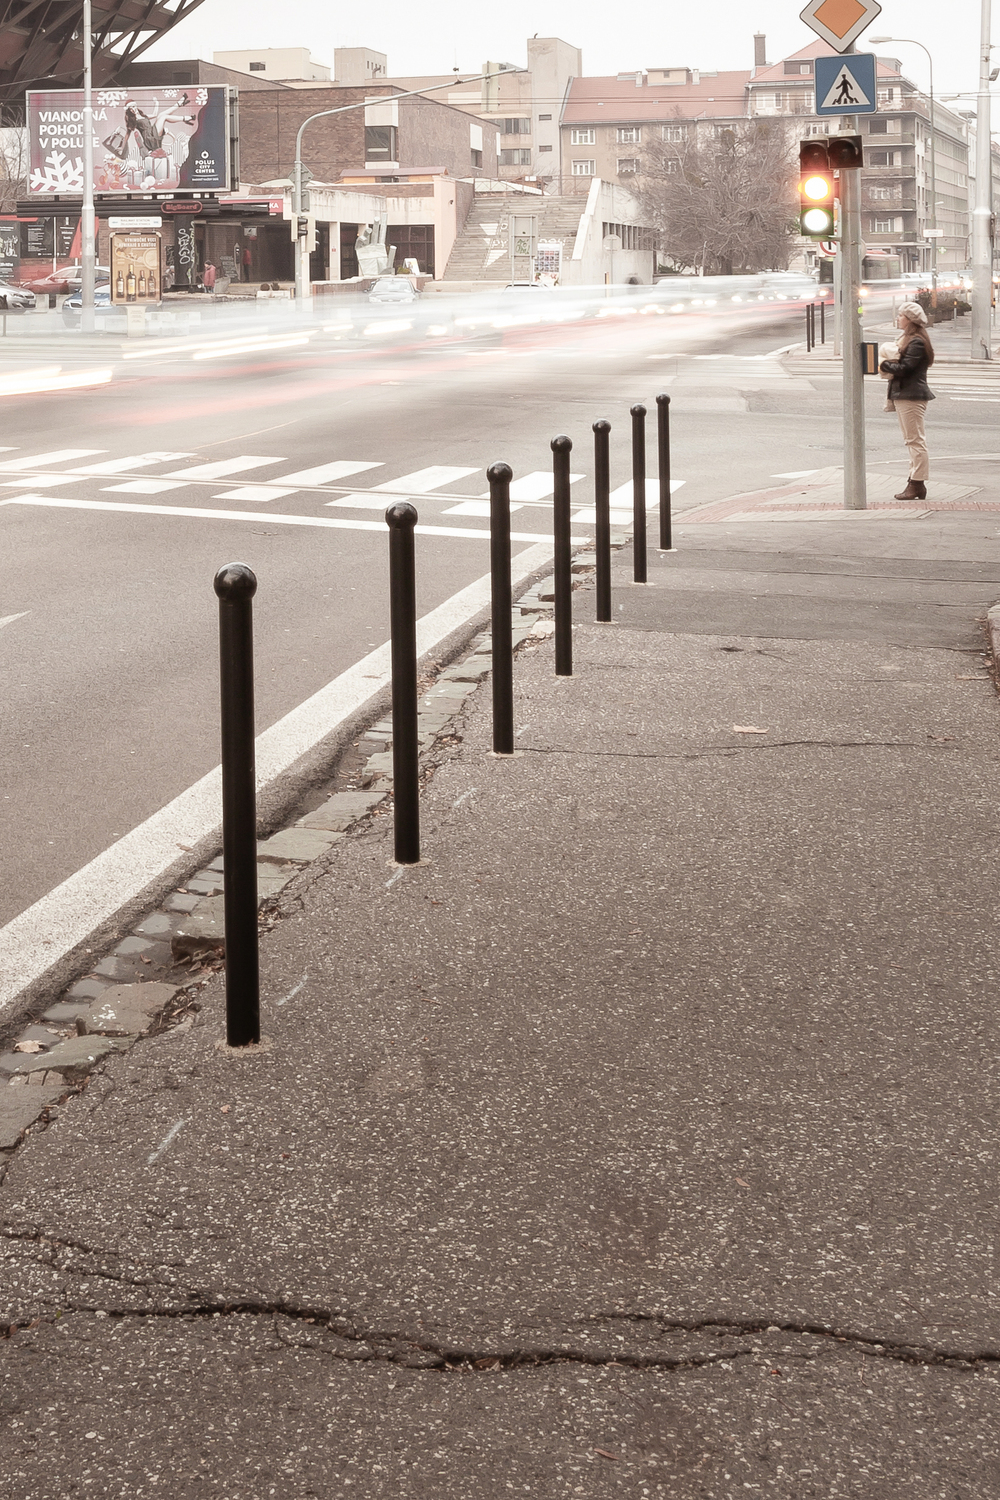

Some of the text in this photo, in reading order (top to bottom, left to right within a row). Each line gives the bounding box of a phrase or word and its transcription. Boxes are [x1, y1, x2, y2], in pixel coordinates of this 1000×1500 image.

[38, 107, 108, 122] VIANONÁ
[38, 137, 100, 149] V POLUE
